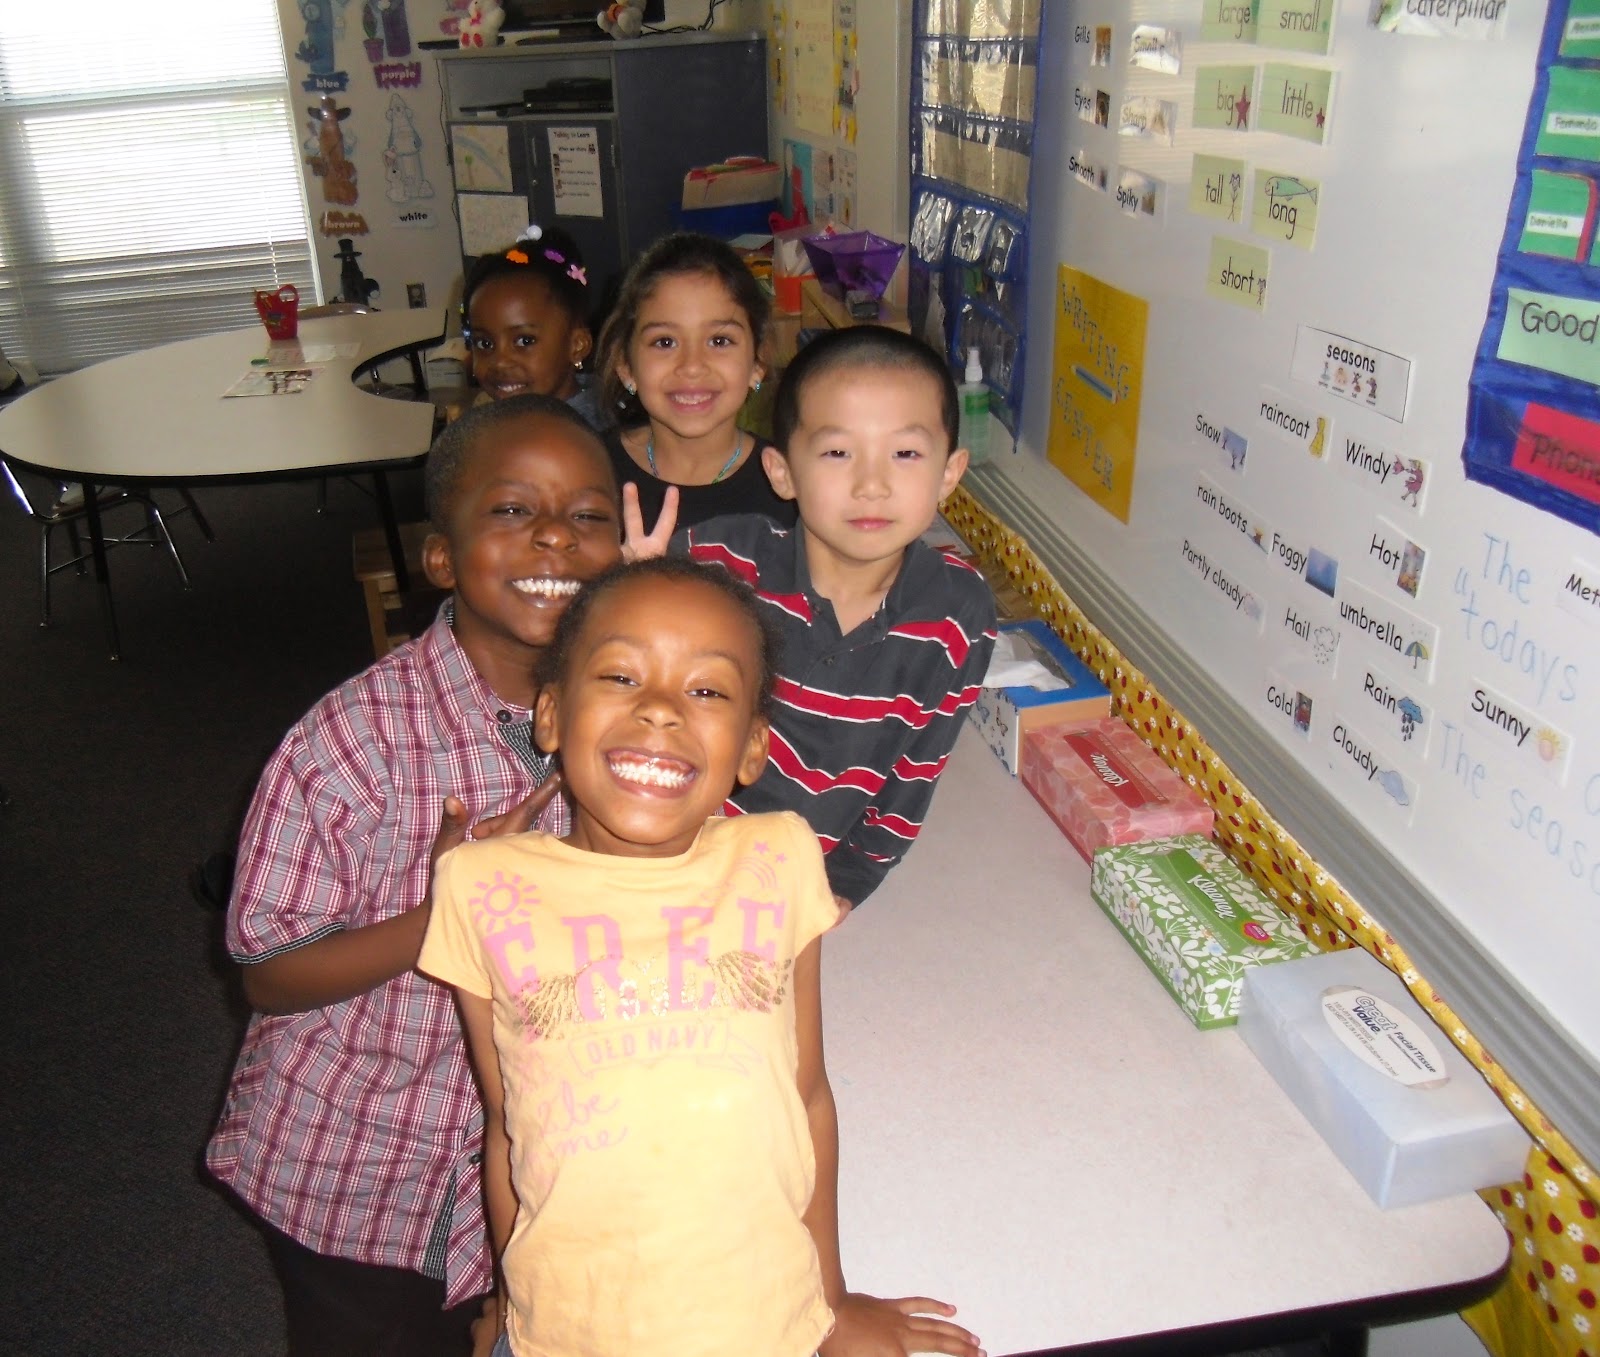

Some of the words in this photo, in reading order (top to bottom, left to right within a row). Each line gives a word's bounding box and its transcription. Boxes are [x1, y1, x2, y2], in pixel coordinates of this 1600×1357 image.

[1074, 25, 1091, 44] Gills
[1218, 0, 1251, 39] large
[1279, 0, 1320, 32] small
[316, 78, 340, 89] blue
[381, 69, 417, 81] purple
[1074, 87, 1091, 111] Eyes
[1217, 80, 1235, 126] big
[1282, 80, 1313, 118] little
[1068, 156, 1095, 183] Smooth
[1116, 185, 1139, 213] Spiky
[1206, 175, 1224, 205] tall
[326, 219, 361, 230] brown
[399, 212, 428, 223] white
[1269, 185, 1298, 240] long
[1221, 257, 1255, 294] short
[1061, 283, 1129, 400] WRITING
[1521, 302, 1600, 344] Good
[1326, 344, 1376, 373] seasons
[1055, 377, 1114, 492] CENTER
[1195, 414, 1222, 444] Snow
[1260, 401, 1310, 439] raincoat
[1345, 439, 1391, 484] Windy
[1196, 485, 1217, 510] rain
[1218, 496, 1248, 533] boots
[1272, 533, 1308, 574] Foggy
[1369, 533, 1401, 570] Hot
[1483, 532, 1531, 604] The
[1182, 539, 1211, 580] Partly
[1212, 569, 1244, 610] cloudy
[1565, 573, 1600, 608] Met
[1285, 607, 1310, 642] Hail
[1340, 601, 1402, 652] umbrella
[1267, 686, 1293, 718] Cold
[1364, 672, 1396, 714] Rain
[1471, 689, 1531, 747] Sunny
[1090, 753, 1129, 787] Kleenex
[1333, 725, 1379, 781] Cloudy
[1441, 719, 1486, 799] The
[1187, 873, 1237, 919] Kleenex
[1352, 1006, 1381, 1033] Value
[1355, 995, 1398, 1031] Great
[586, 1032, 636, 1064] OLD
[648, 1025, 716, 1053] NAVY
[1394, 1031, 1418, 1051] Facial
[1413, 1050, 1436, 1073] Tissue
[560, 1079, 621, 1134] be
[552, 1126, 630, 1156] me
